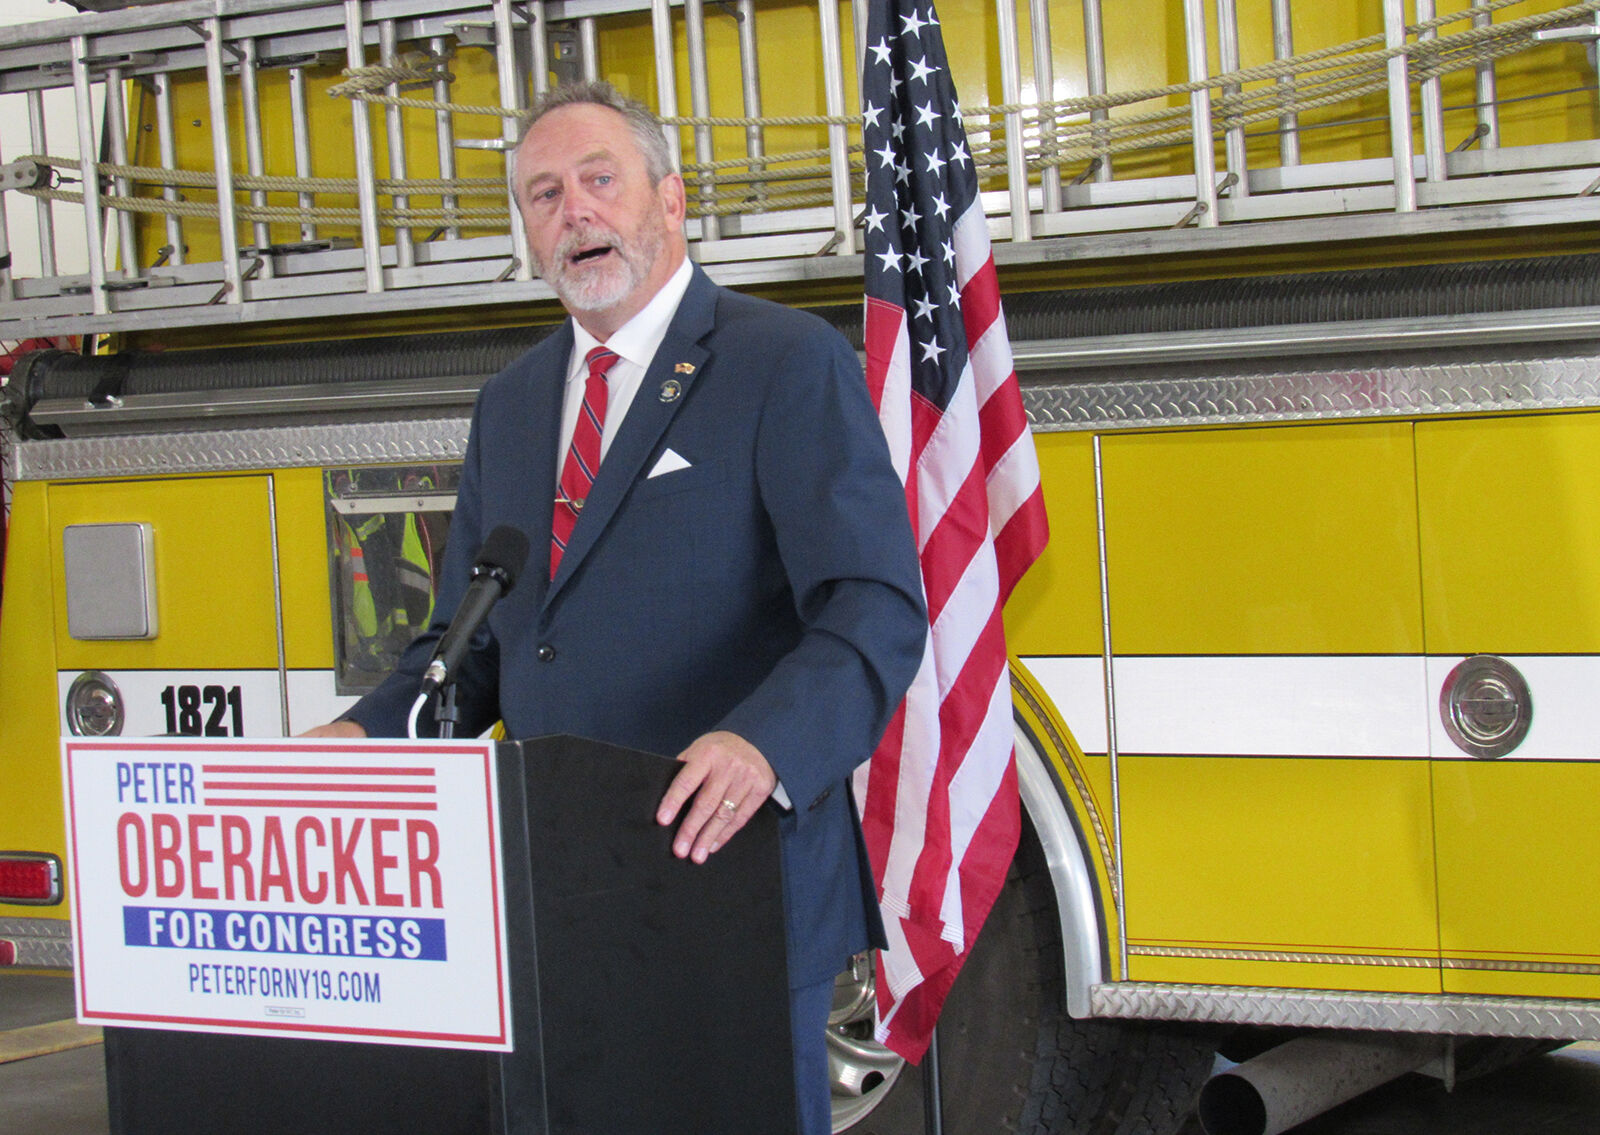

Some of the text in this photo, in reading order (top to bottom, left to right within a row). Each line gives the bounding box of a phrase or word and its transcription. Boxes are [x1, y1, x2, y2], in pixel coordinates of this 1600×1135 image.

[161, 685, 244, 737] 1821
[116, 761, 196, 804] PETER
[116, 812, 444, 908] OBERACKER
[148, 910, 422, 959] FOR CONGRESS
[189, 963, 381, 1003] PETERFORNY19.COM
